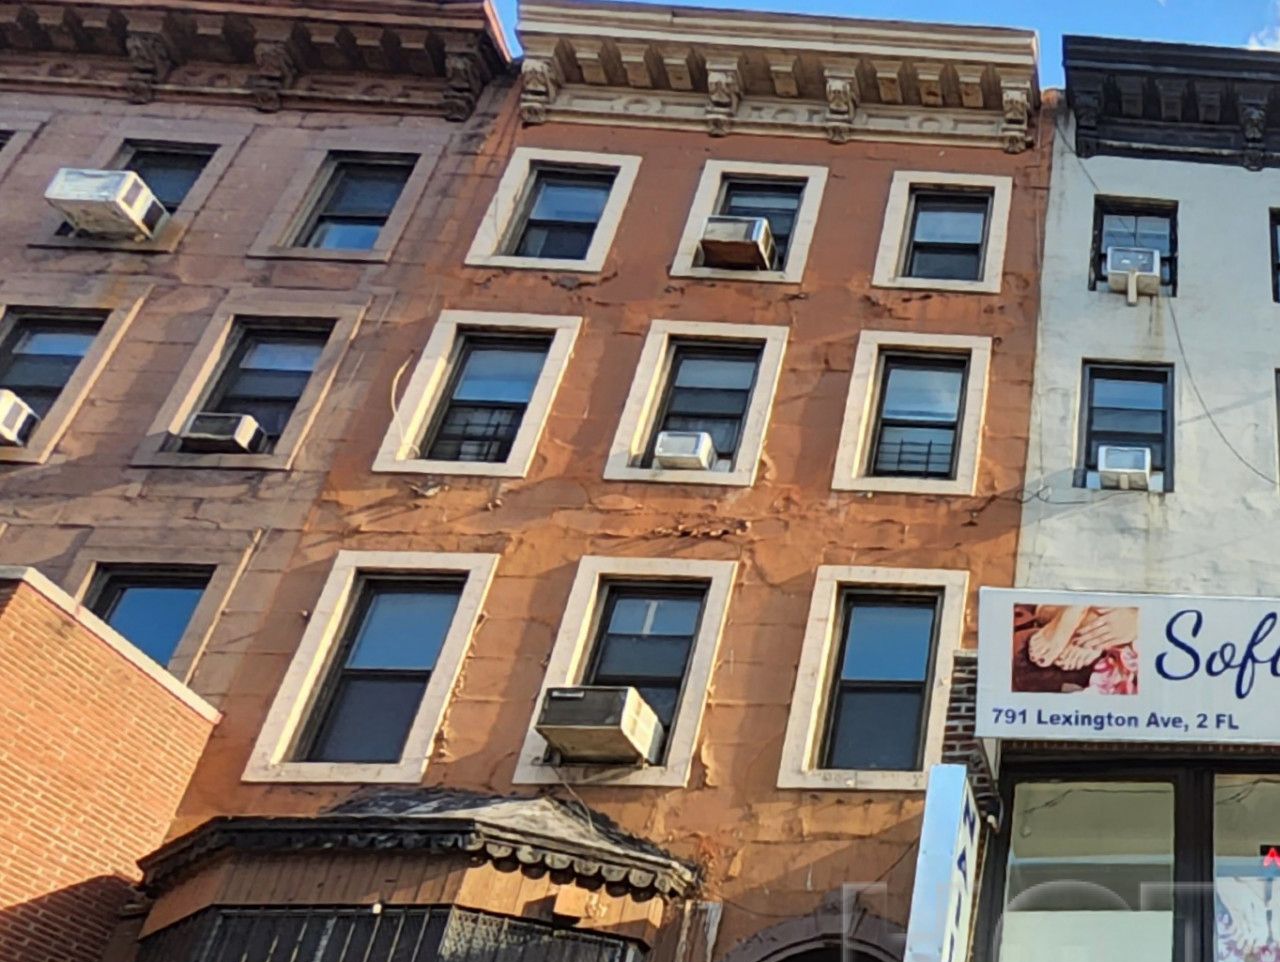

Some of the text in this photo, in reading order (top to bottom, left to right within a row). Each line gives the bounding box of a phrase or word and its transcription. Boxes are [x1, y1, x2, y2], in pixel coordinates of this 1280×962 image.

[992, 708, 1239, 731] 791 Lexington Ave, 2 FL
